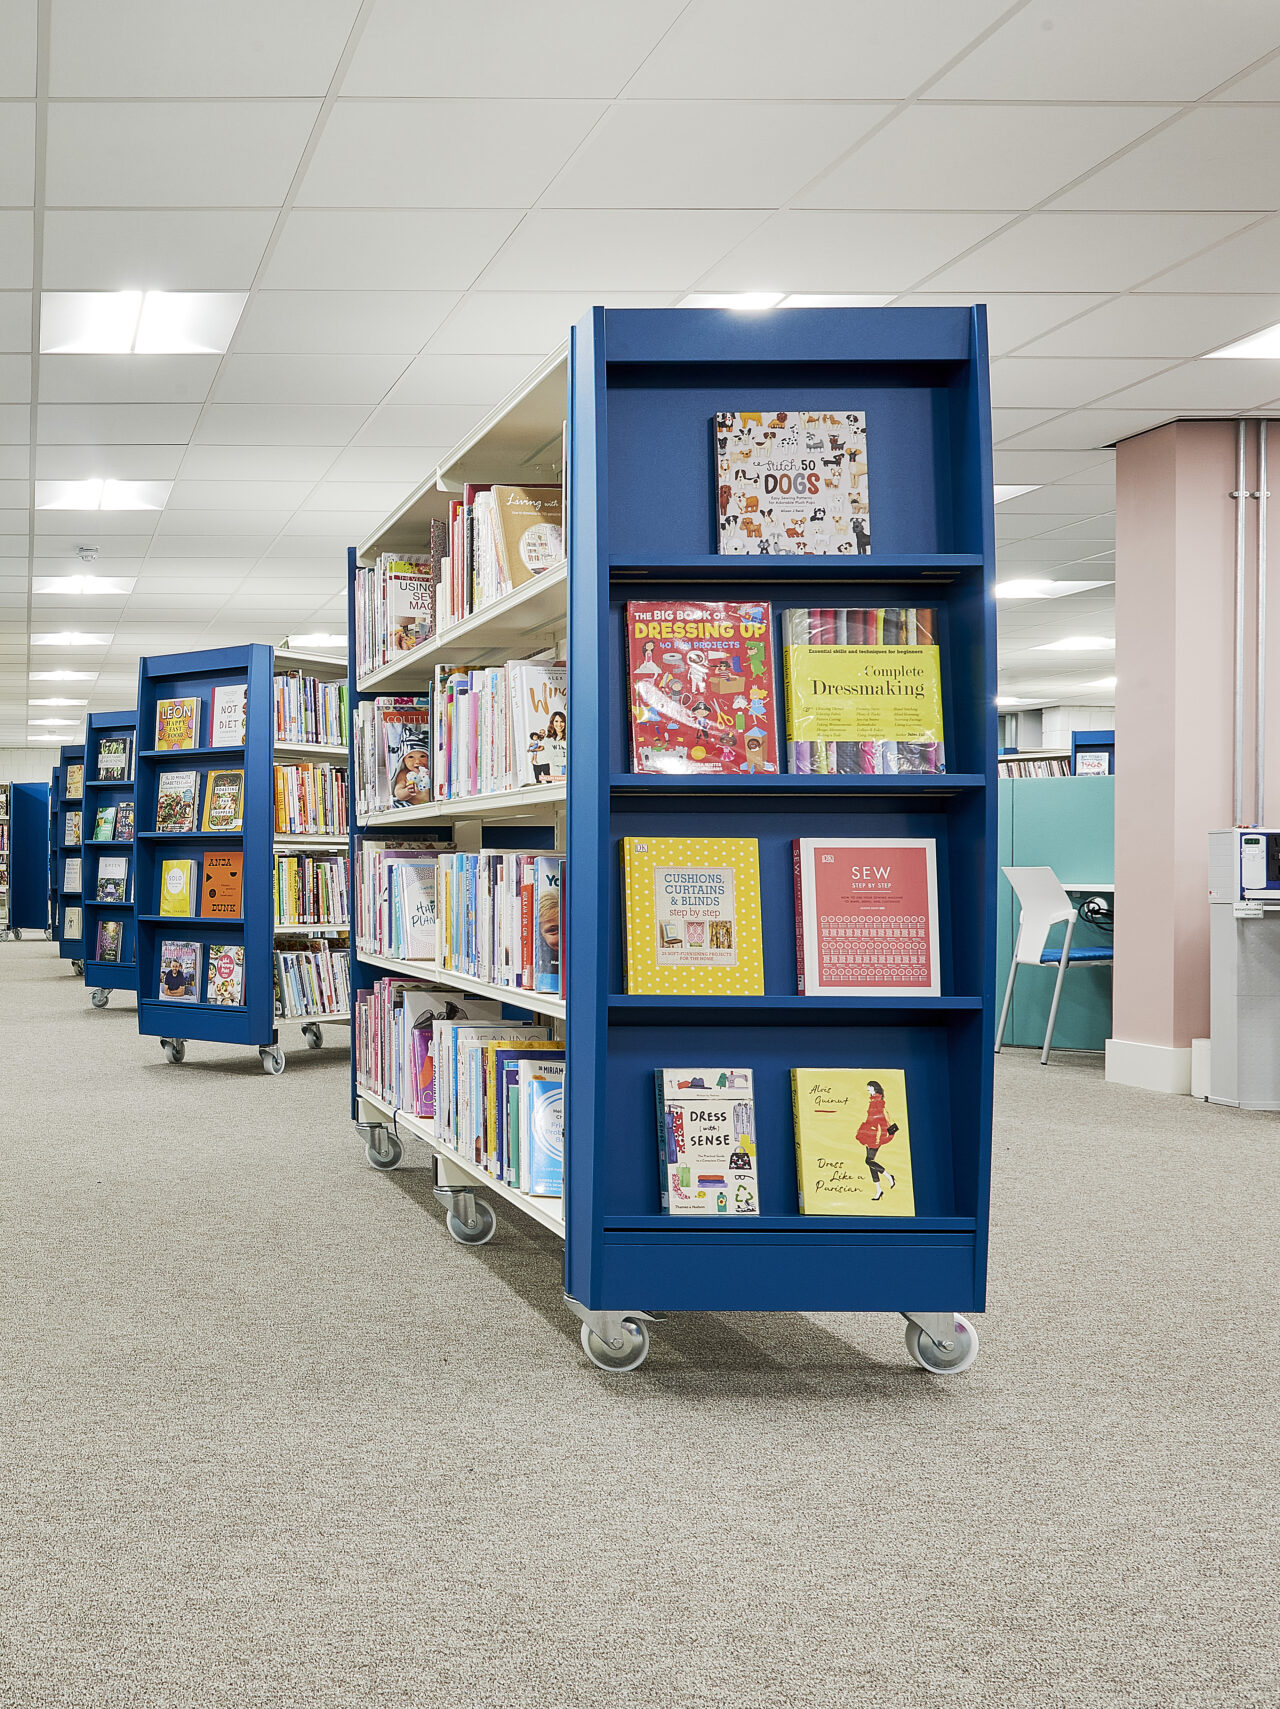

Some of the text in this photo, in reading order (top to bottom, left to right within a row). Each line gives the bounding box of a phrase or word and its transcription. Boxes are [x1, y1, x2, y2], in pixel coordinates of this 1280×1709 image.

[801, 460, 816, 471] 50
[764, 472, 821, 494] DOGS
[506, 492, 542, 510] Living
[634, 610, 726, 620] THE BIG BOOK OF
[634, 622, 766, 640] DRESSING UP
[694, 641, 740, 649] PROJECTS
[864, 665, 924, 680] Complete
[810, 680, 925, 699] Dressmaking
[162, 704, 192, 719] LEON
[221, 704, 238, 714] NOT
[220, 720, 238, 729] DIET
[386, 716, 429, 724] COUTU
[851, 866, 891, 880] SEW
[664, 874, 725, 884] CUSHIONS,
[664, 884, 725, 894] CURTAINS
[670, 896, 720, 906] & BLINDS
[212, 904, 236, 912] DUNK
[670, 908, 720, 918] step by step
[544, 1066, 564, 1074] MIRIAM
[690, 1111, 727, 1122] DRESS
[690, 1134, 730, 1146] SENSE
[817, 1158, 844, 1169] Dress
[830, 1171, 853, 1182] Like
[816, 1180, 863, 1193] Parisian
